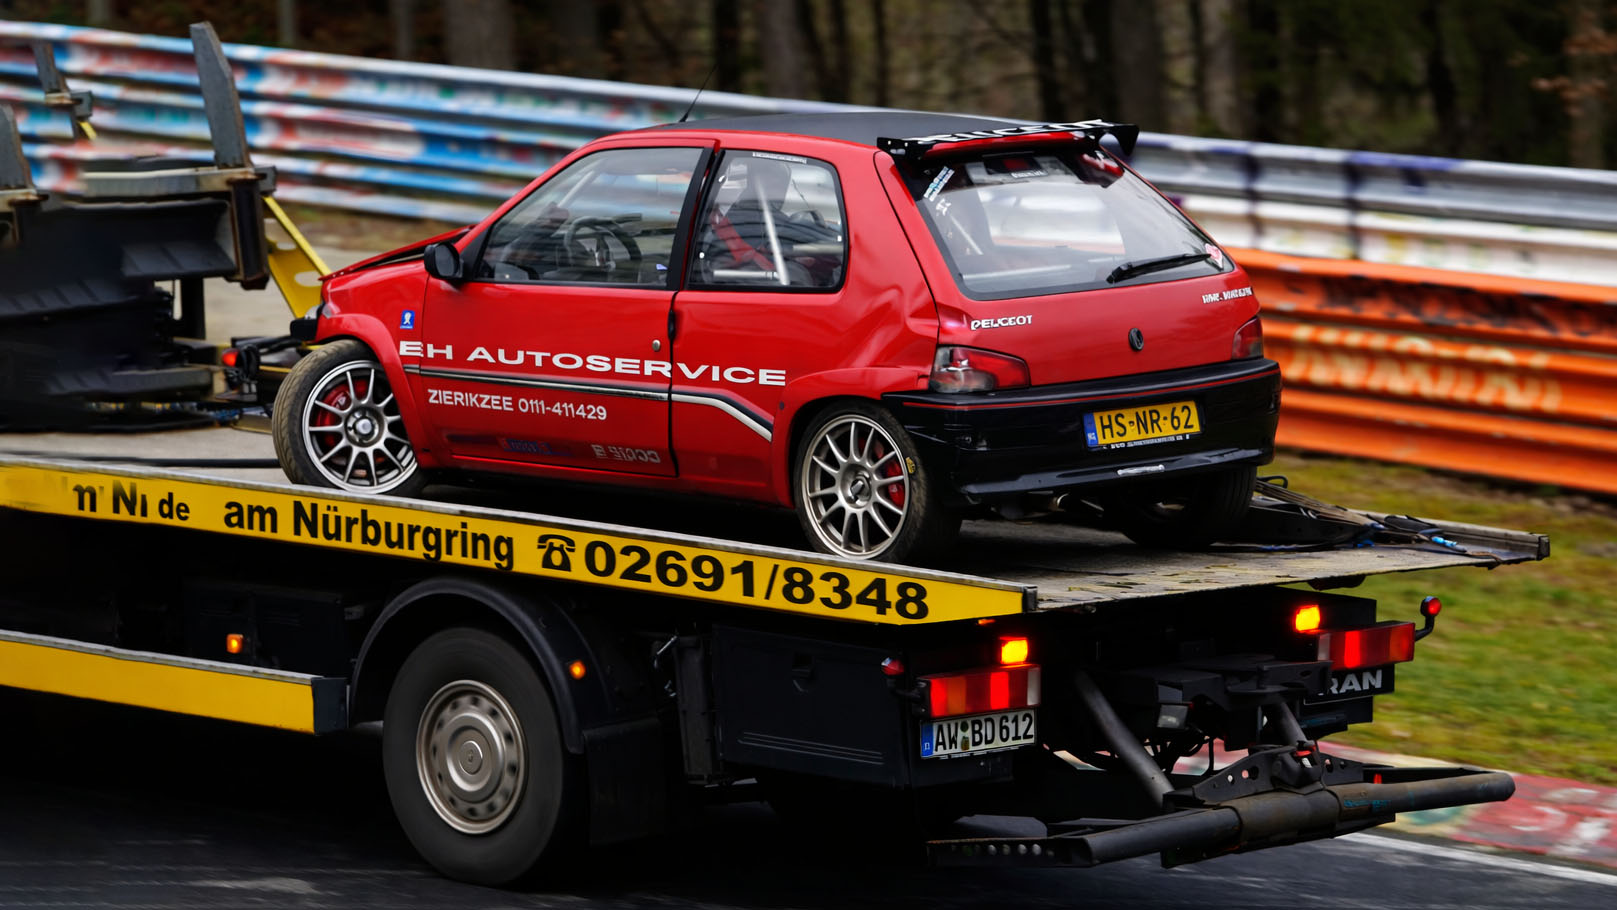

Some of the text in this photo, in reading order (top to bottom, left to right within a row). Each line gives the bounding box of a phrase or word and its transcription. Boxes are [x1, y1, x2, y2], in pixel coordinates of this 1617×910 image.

[399, 340, 787, 387] EH AUTOSERVICE
[427, 388, 608, 421] ZIERIKZEE 0111-411429
[223, 500, 279, 534] am
[292, 499, 514, 571] Nürburgring
[584, 540, 930, 620] 02691/8348
